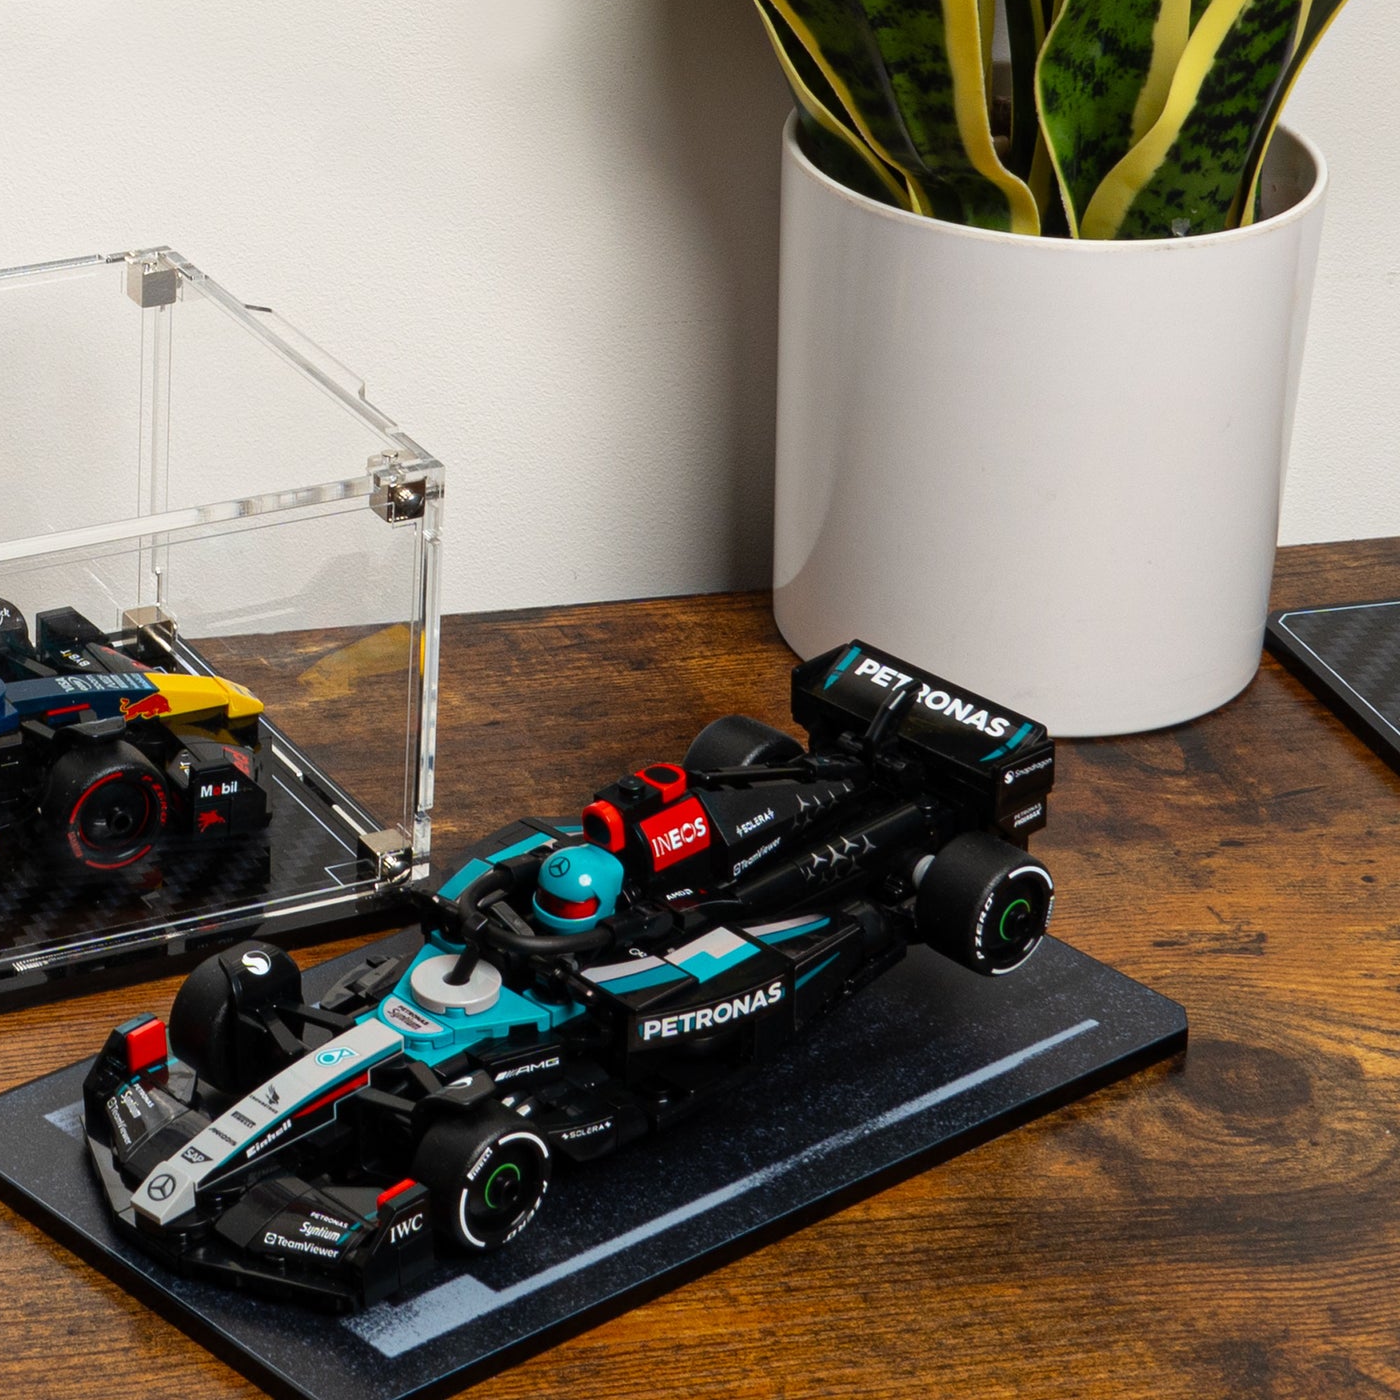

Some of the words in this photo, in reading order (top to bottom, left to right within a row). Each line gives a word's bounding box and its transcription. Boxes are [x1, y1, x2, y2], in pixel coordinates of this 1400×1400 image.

[854, 658, 1011, 737] PETRONAS
[200, 780, 238, 799] Mobil
[741, 812, 769, 834] SOLERA
[652, 817, 707, 858] INEOS
[643, 981, 782, 1041] PETRONAS
[517, 1057, 561, 1076] AMG
[245, 1118, 292, 1159] Einhell
[569, 1123, 605, 1139] SOLERA
[299, 1220, 341, 1242] Syntium
[310, 1211, 349, 1229] PETRONAS
[389, 1213, 424, 1244] IWC
[277, 1235, 340, 1259] TeamViewer
